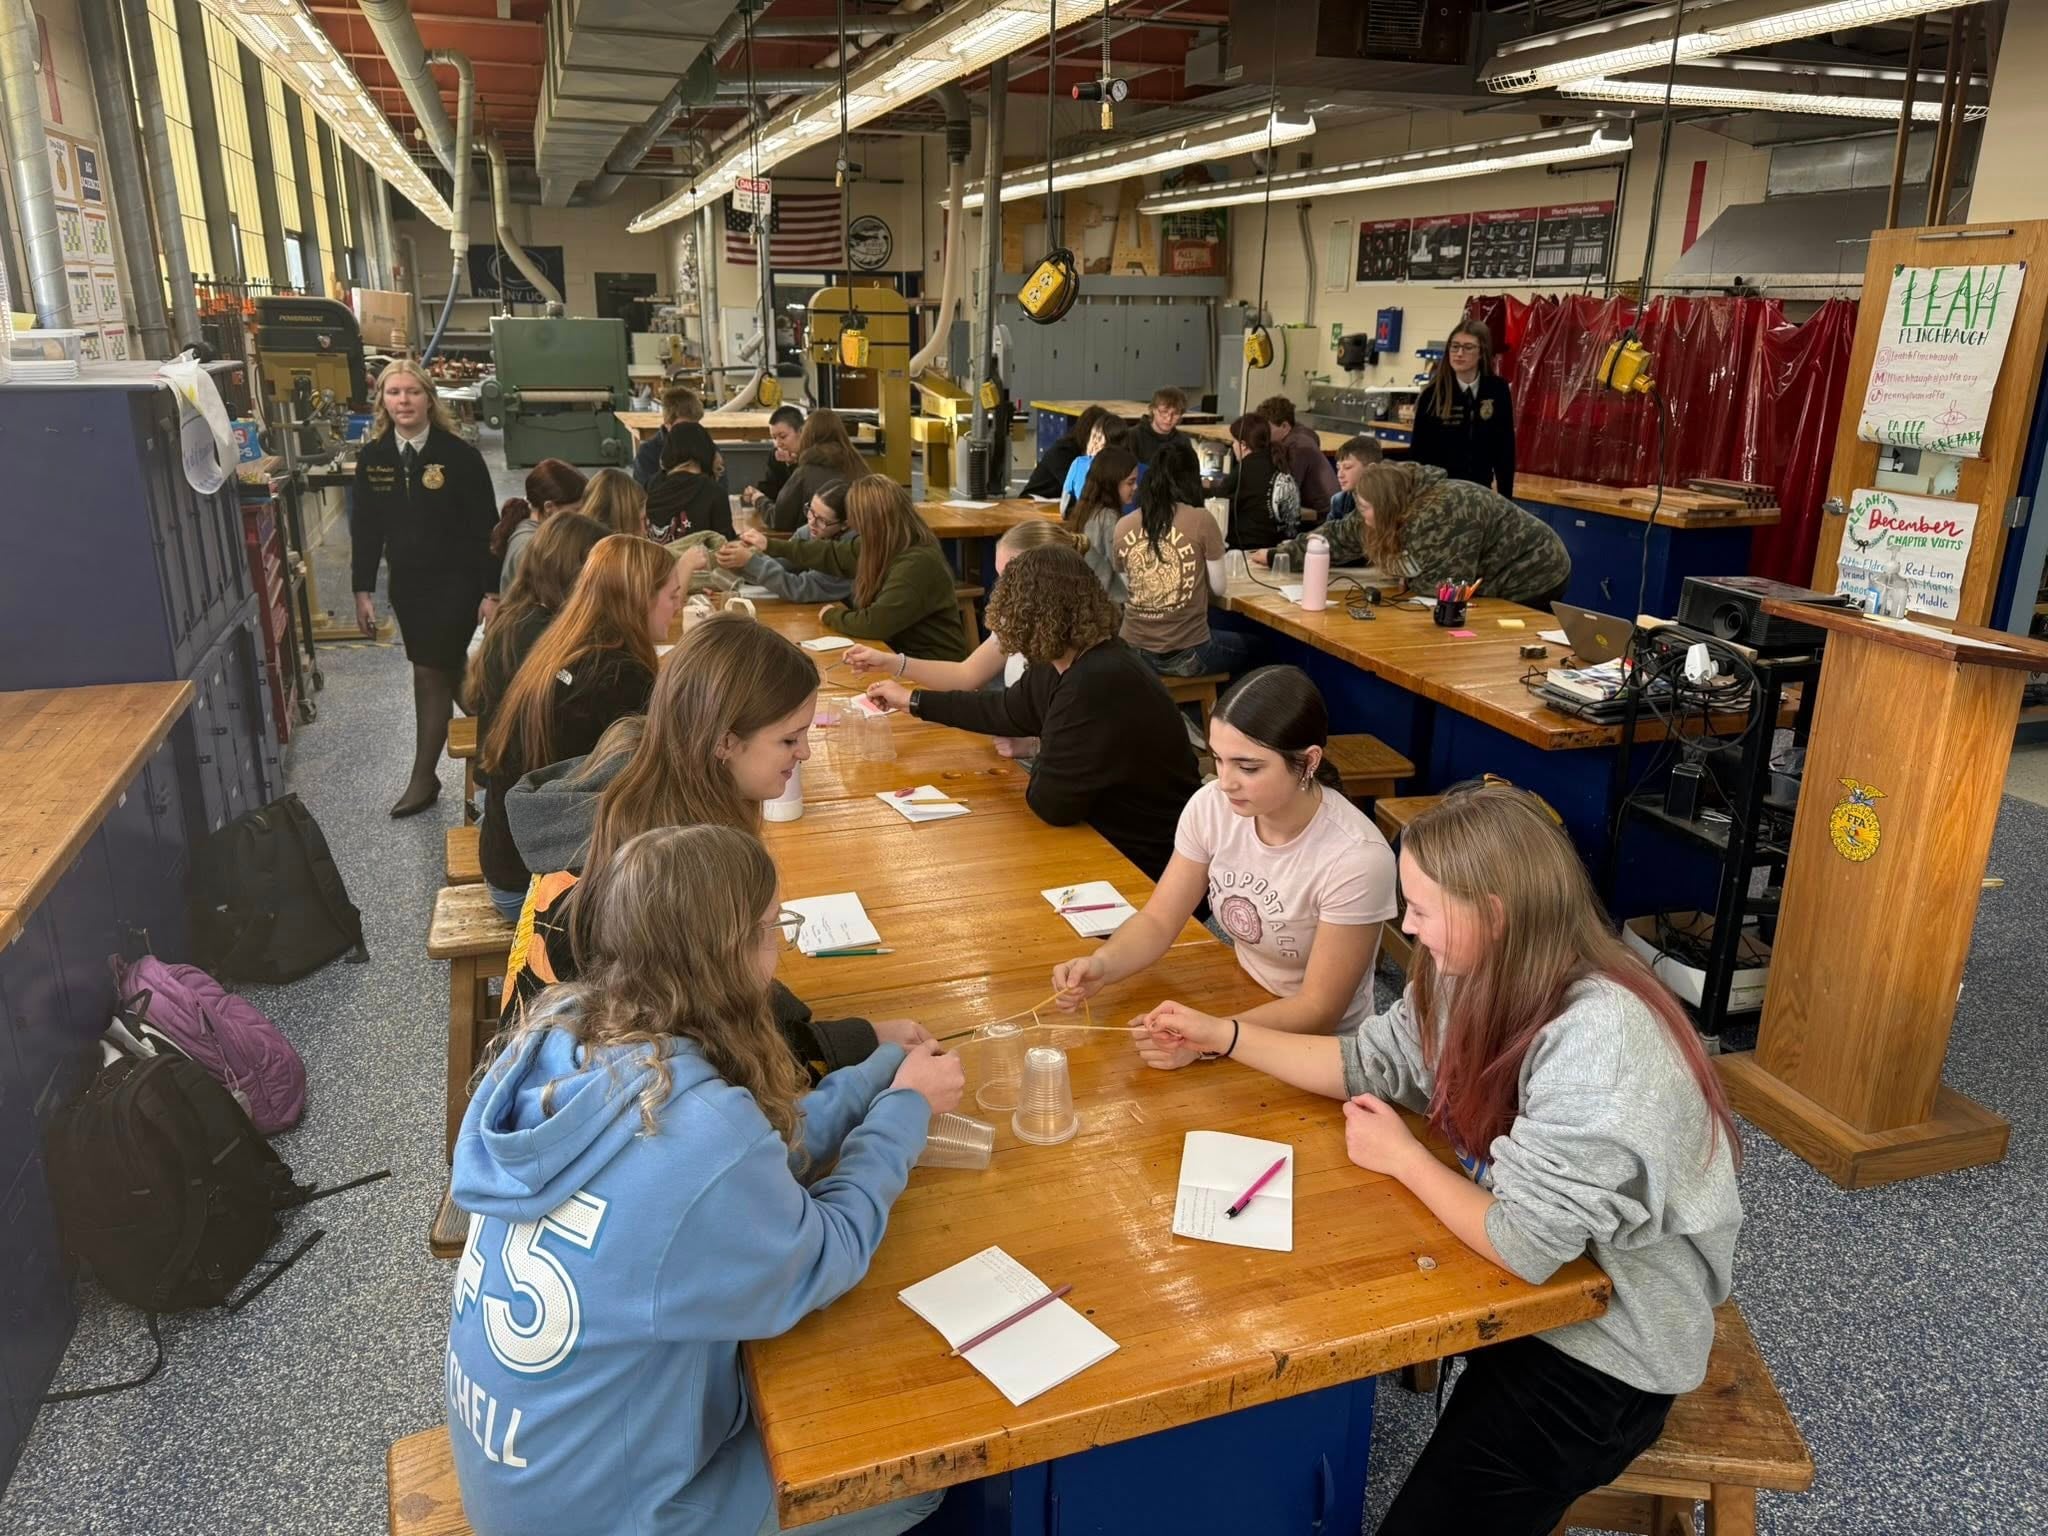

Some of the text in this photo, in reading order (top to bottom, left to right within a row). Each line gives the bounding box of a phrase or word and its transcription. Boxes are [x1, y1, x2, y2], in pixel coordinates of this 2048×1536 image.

[740, 179, 767, 192] DANGER
[1902, 265, 2006, 330] LEAH
[1898, 327, 1989, 346] FLINCHBAUGH
[1888, 431, 1923, 446] STATE
[1868, 508, 1964, 537] December
[1886, 534, 1963, 551] CHAPTER VISITS
[1904, 562, 1954, 580] Red Lion
[1915, 593, 1949, 609] Middle
[1847, 813, 1866, 829] FFA
[449, 1348, 528, 1468] CHELL
